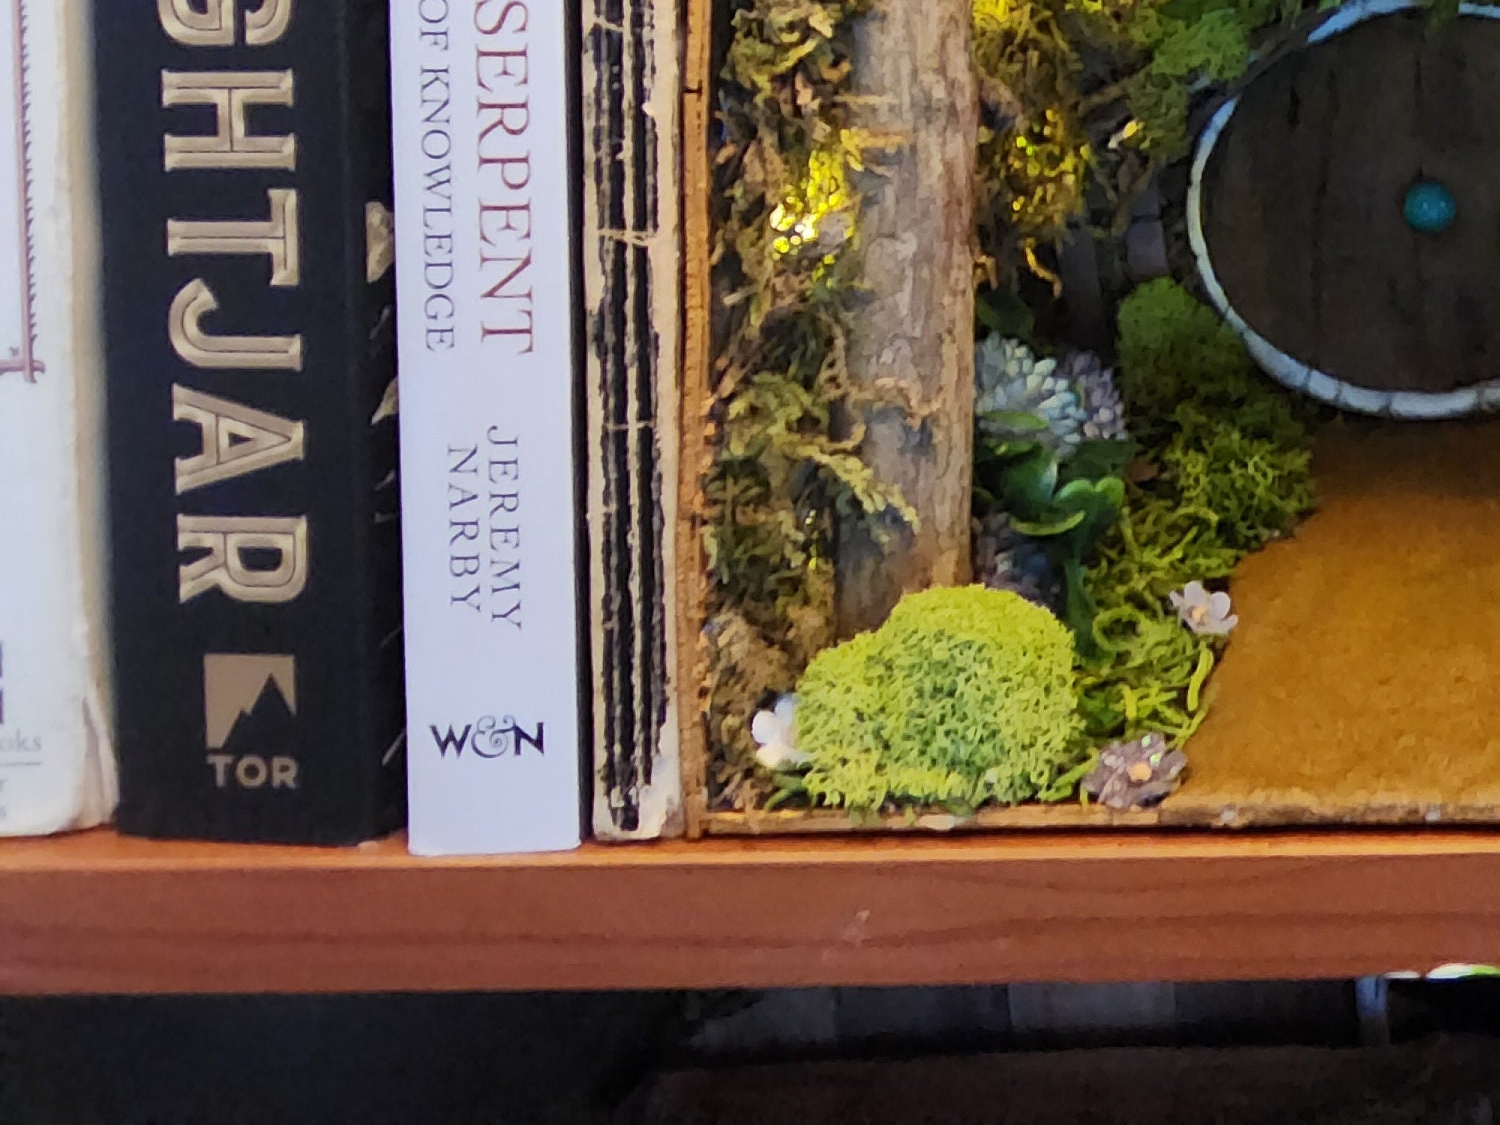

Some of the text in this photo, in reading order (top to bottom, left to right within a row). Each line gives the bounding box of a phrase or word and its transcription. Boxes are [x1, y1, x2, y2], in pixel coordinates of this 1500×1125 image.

[420, 66, 456, 352] KNOWLEDGE
[447, 444, 482, 613] NARBY
[486, 425, 523, 630] JEREMY
[207, 755, 297, 788] TOR
[430, 715, 546, 759] W&N
